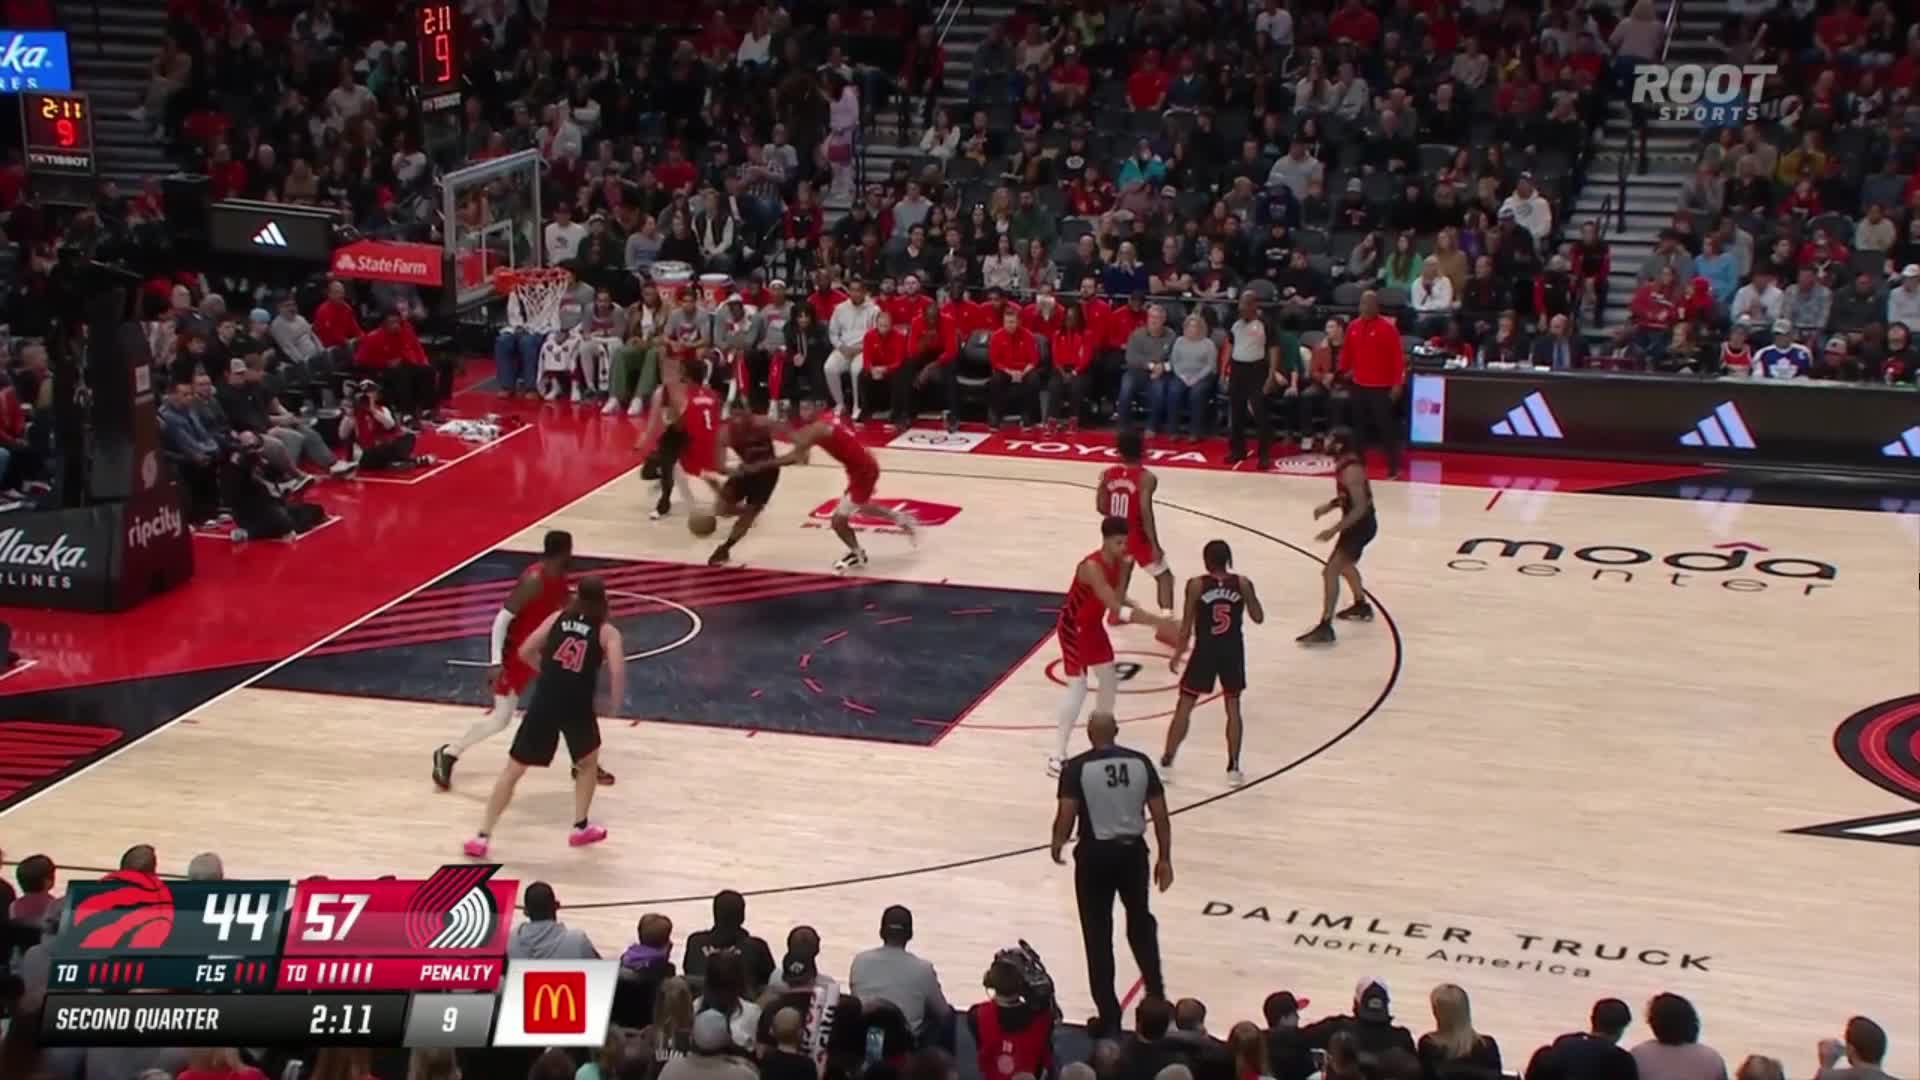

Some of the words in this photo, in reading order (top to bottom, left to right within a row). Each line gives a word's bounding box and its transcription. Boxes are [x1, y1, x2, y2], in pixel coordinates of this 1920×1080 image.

[423, 6, 451, 34] 2:11
[435, 34, 450, 82] 9
[42, 98, 82, 119] 2:11
[56, 119, 74, 146] 9
[357, 255, 391, 273] State
[393, 258, 427, 275] Farm
[1111, 492, 1129, 519] 00
[129, 505, 182, 547] ripcity
[1456, 537, 1836, 581] moda
[1448, 558, 1833, 596] center
[1210, 602, 1232, 635] 5
[552, 636, 588, 672] 41
[1104, 763, 1130, 788] 34
[1202, 900, 1473, 944] DAIMLER
[1517, 934, 1714, 972] TRUCK
[1294, 933, 1403, 958] North
[1427, 949, 1592, 979] America
